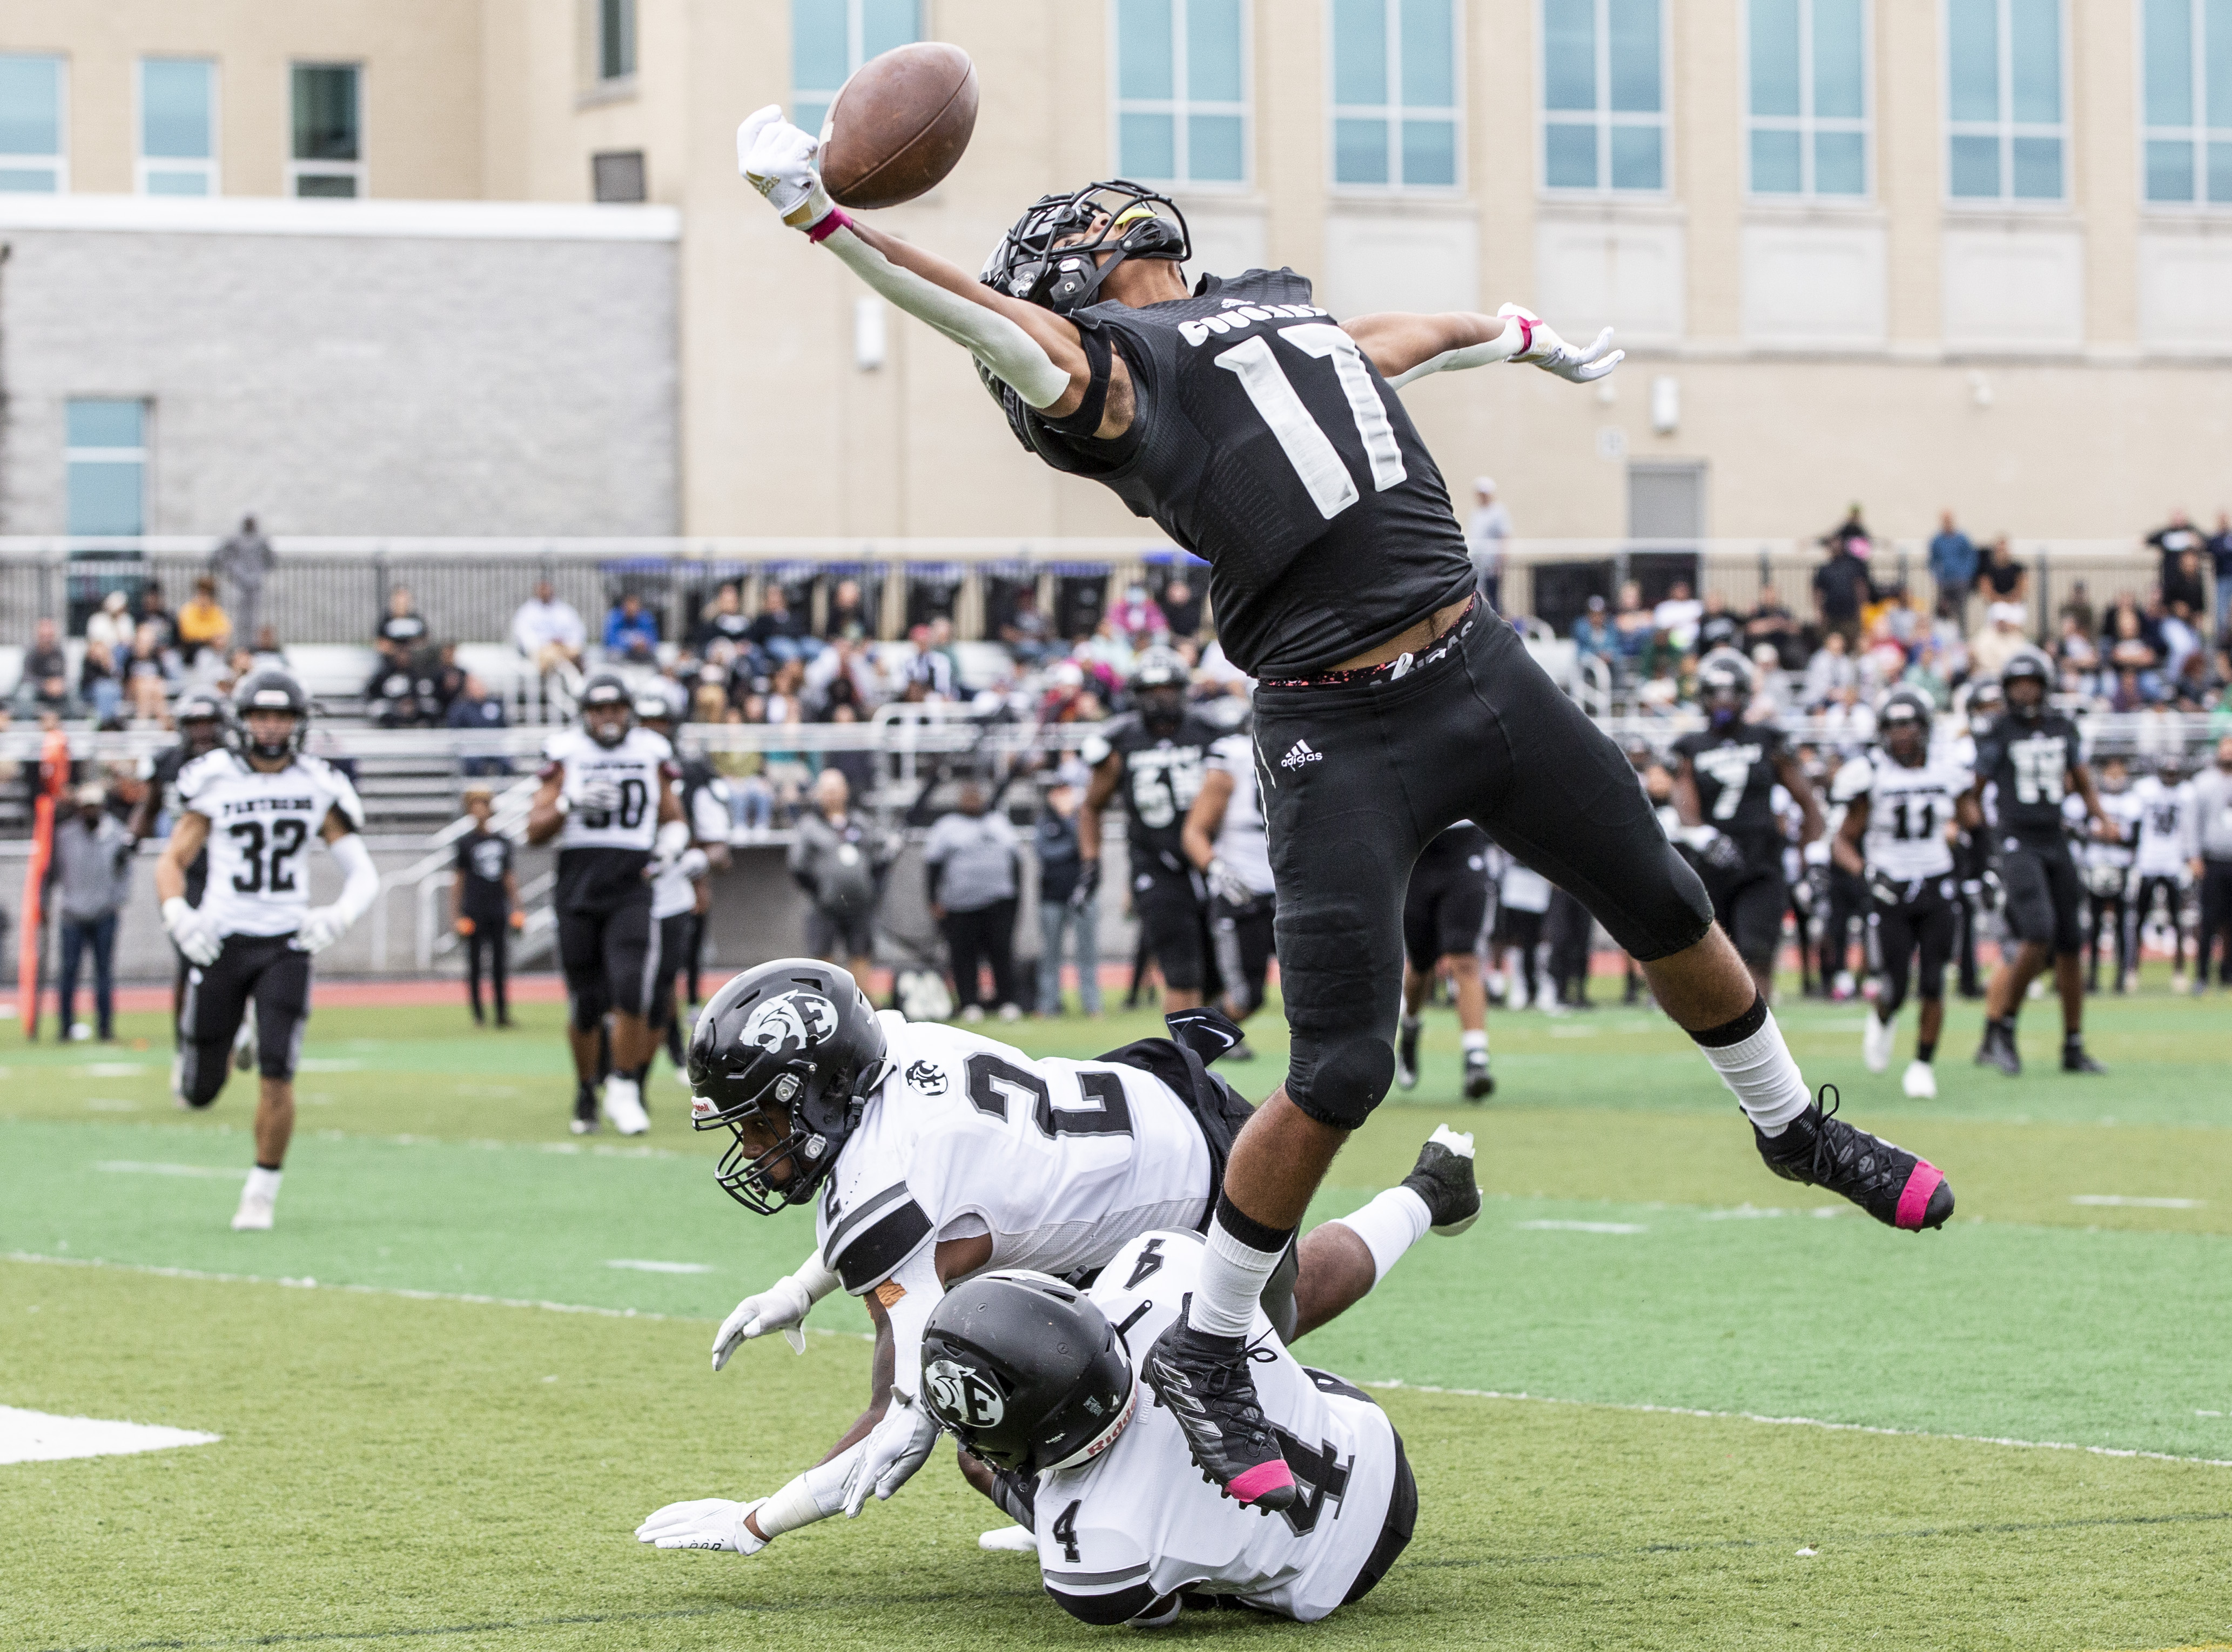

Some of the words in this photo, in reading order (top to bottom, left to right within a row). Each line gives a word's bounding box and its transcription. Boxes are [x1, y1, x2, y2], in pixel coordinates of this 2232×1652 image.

[1214, 322, 1407, 520] 17
[1281, 752, 1323, 767] adidas
[1894, 804, 1933, 839] 11
[230, 818, 307, 893] 32
[963, 1051, 1135, 1141] 2
[823, 1166, 843, 1229] 2
[1122, 1238, 1166, 1291] 4
[1264, 1417, 1355, 1538] 4
[1052, 1499, 1082, 1563] 4
